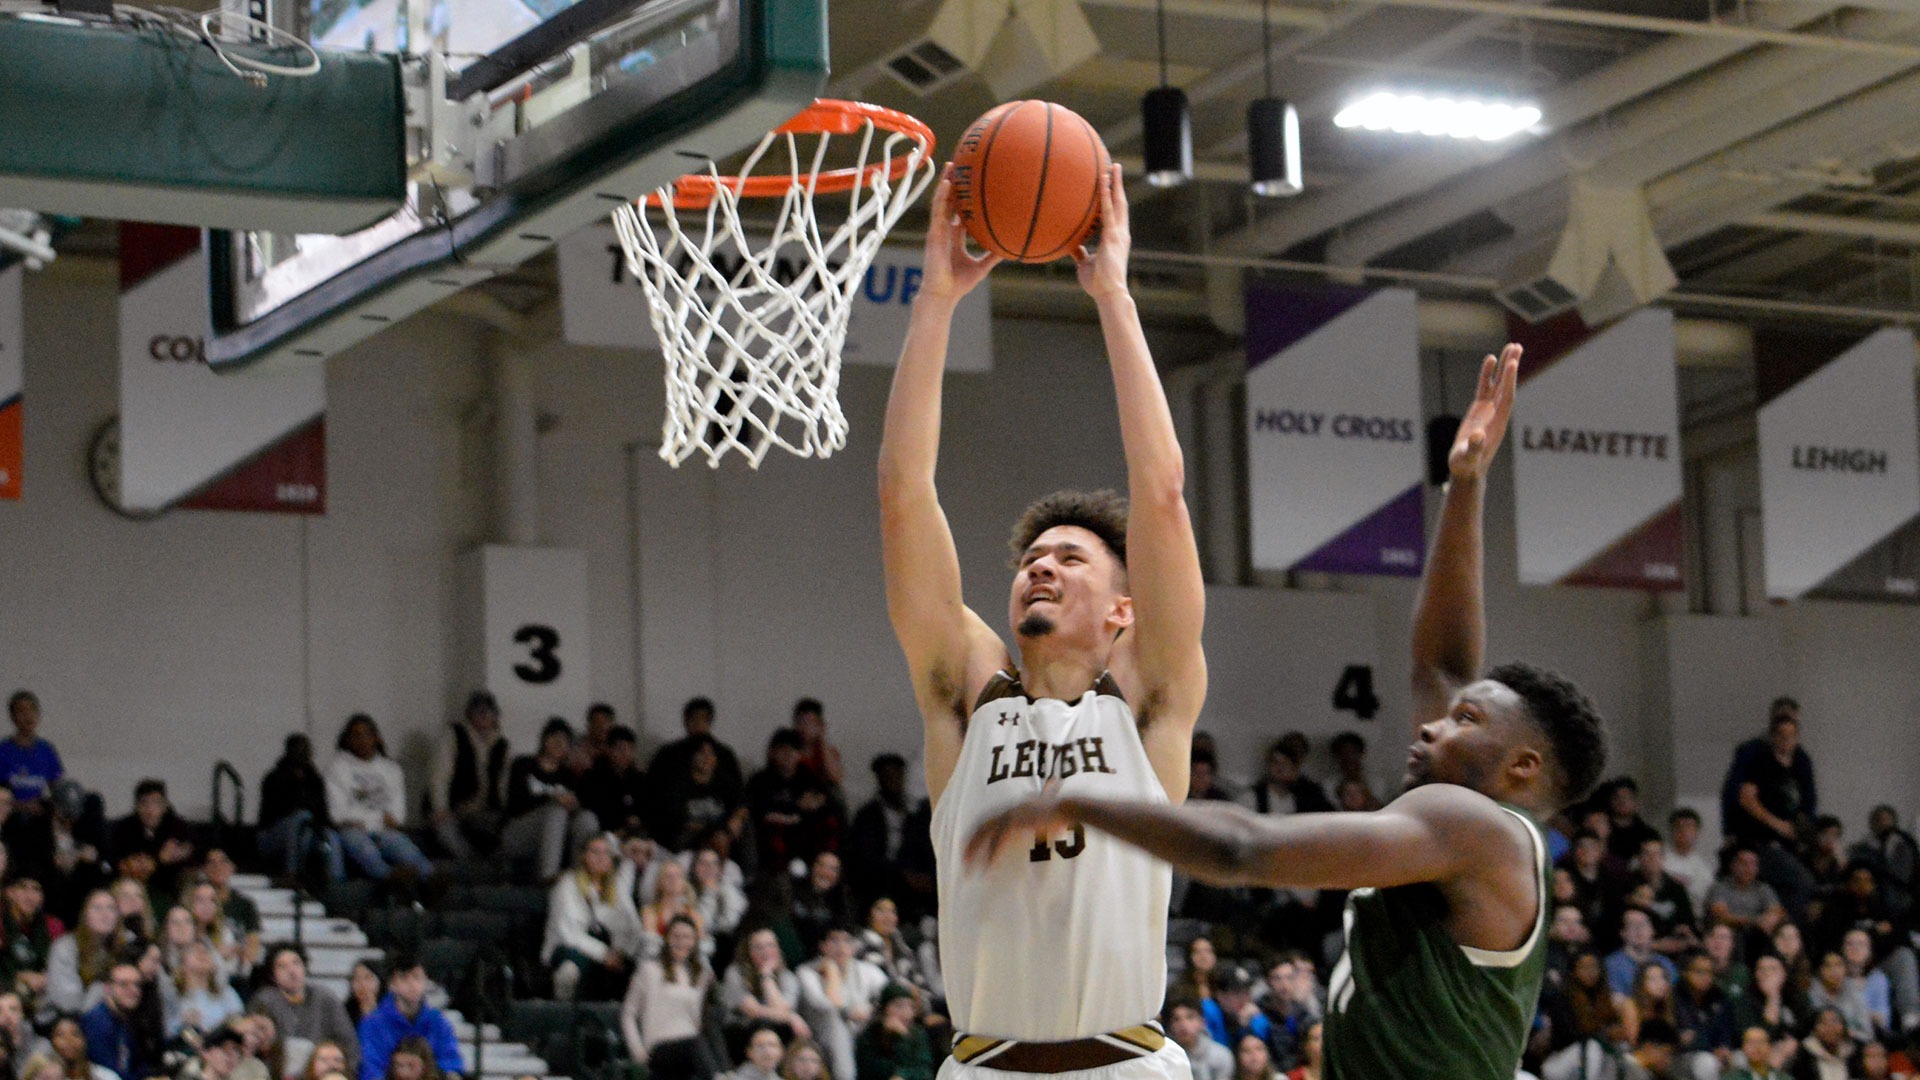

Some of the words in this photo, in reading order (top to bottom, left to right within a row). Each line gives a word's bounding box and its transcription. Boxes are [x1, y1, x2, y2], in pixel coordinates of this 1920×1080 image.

[1255, 408, 1325, 437] HOLY
[1332, 414, 1414, 443] CROSS
[1522, 425, 1668, 461] LAFAYETTE
[1791, 445, 1887, 475] LEHIGH
[513, 625, 562, 684] 3
[1332, 663, 1380, 719] 4
